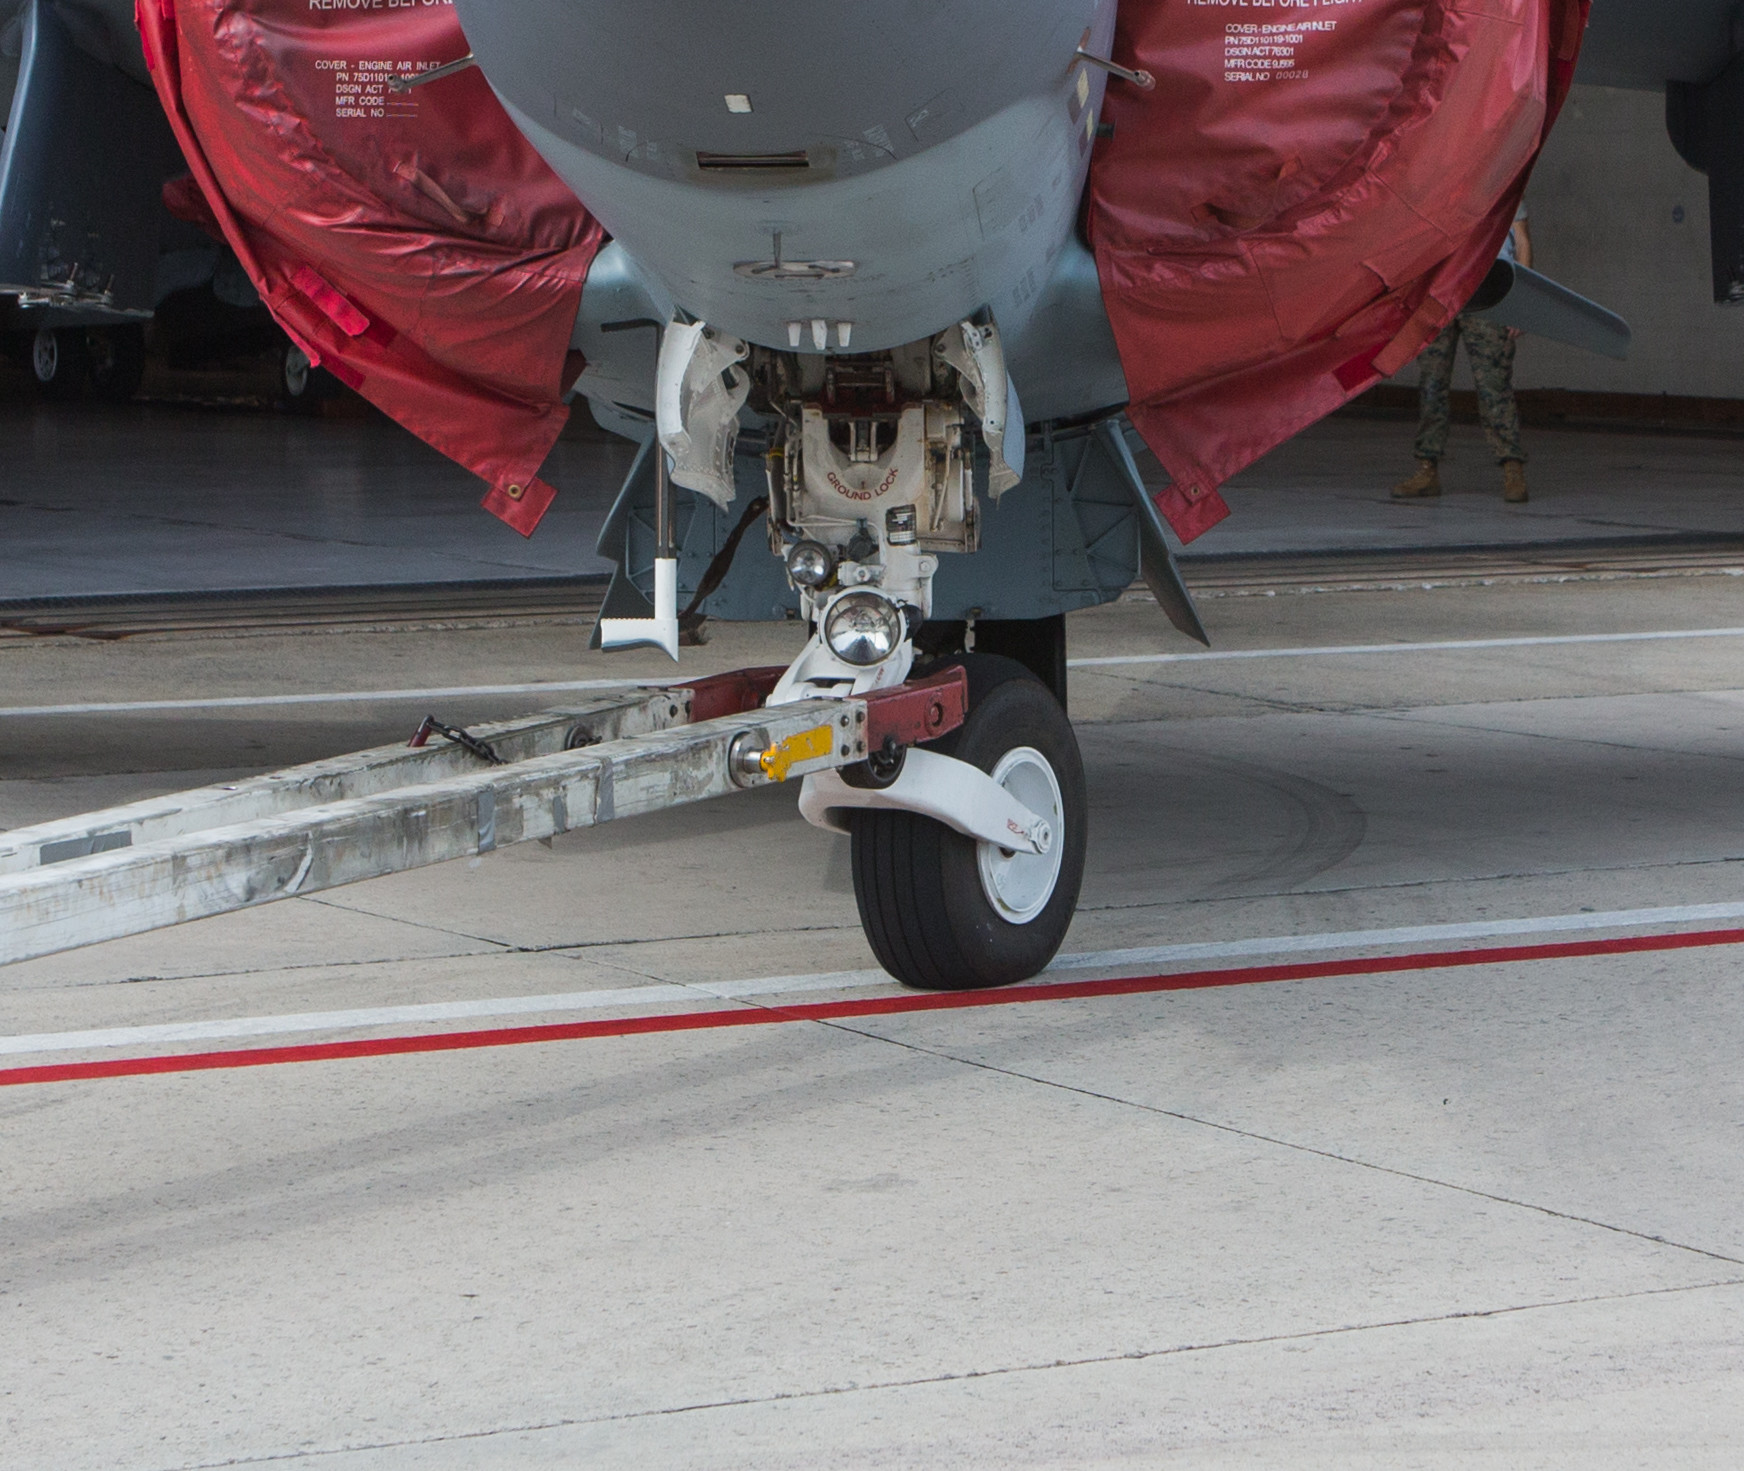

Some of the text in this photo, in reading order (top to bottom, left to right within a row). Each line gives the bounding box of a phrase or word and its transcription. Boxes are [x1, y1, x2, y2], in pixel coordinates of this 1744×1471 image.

[1225, 23, 1257, 33] COVER
[1262, 23, 1296, 34] ENGINE
[1296, 22, 1312, 31] AIR
[1312, 21, 1337, 31] INLET
[1252, 46, 1270, 56] ACT
[315, 60, 347, 70] COVER
[359, 61, 393, 70] ENGINE
[397, 61, 412, 70] AIR
[416, 61, 441, 70] INLET
[1224, 59, 1245, 69] MFR
[1246, 59, 1271, 69] CODE
[336, 72, 349, 81] PN
[1224, 72, 1254, 81] SERIAL
[1255, 72, 1270, 81] NO
[336, 84, 361, 93] DSGN
[365, 85, 384, 93] ACT
[336, 96, 384, 105] MFR CODE
[336, 108, 384, 117] SERIAL NO
[827, 467, 899, 501] GROUND LOCK
